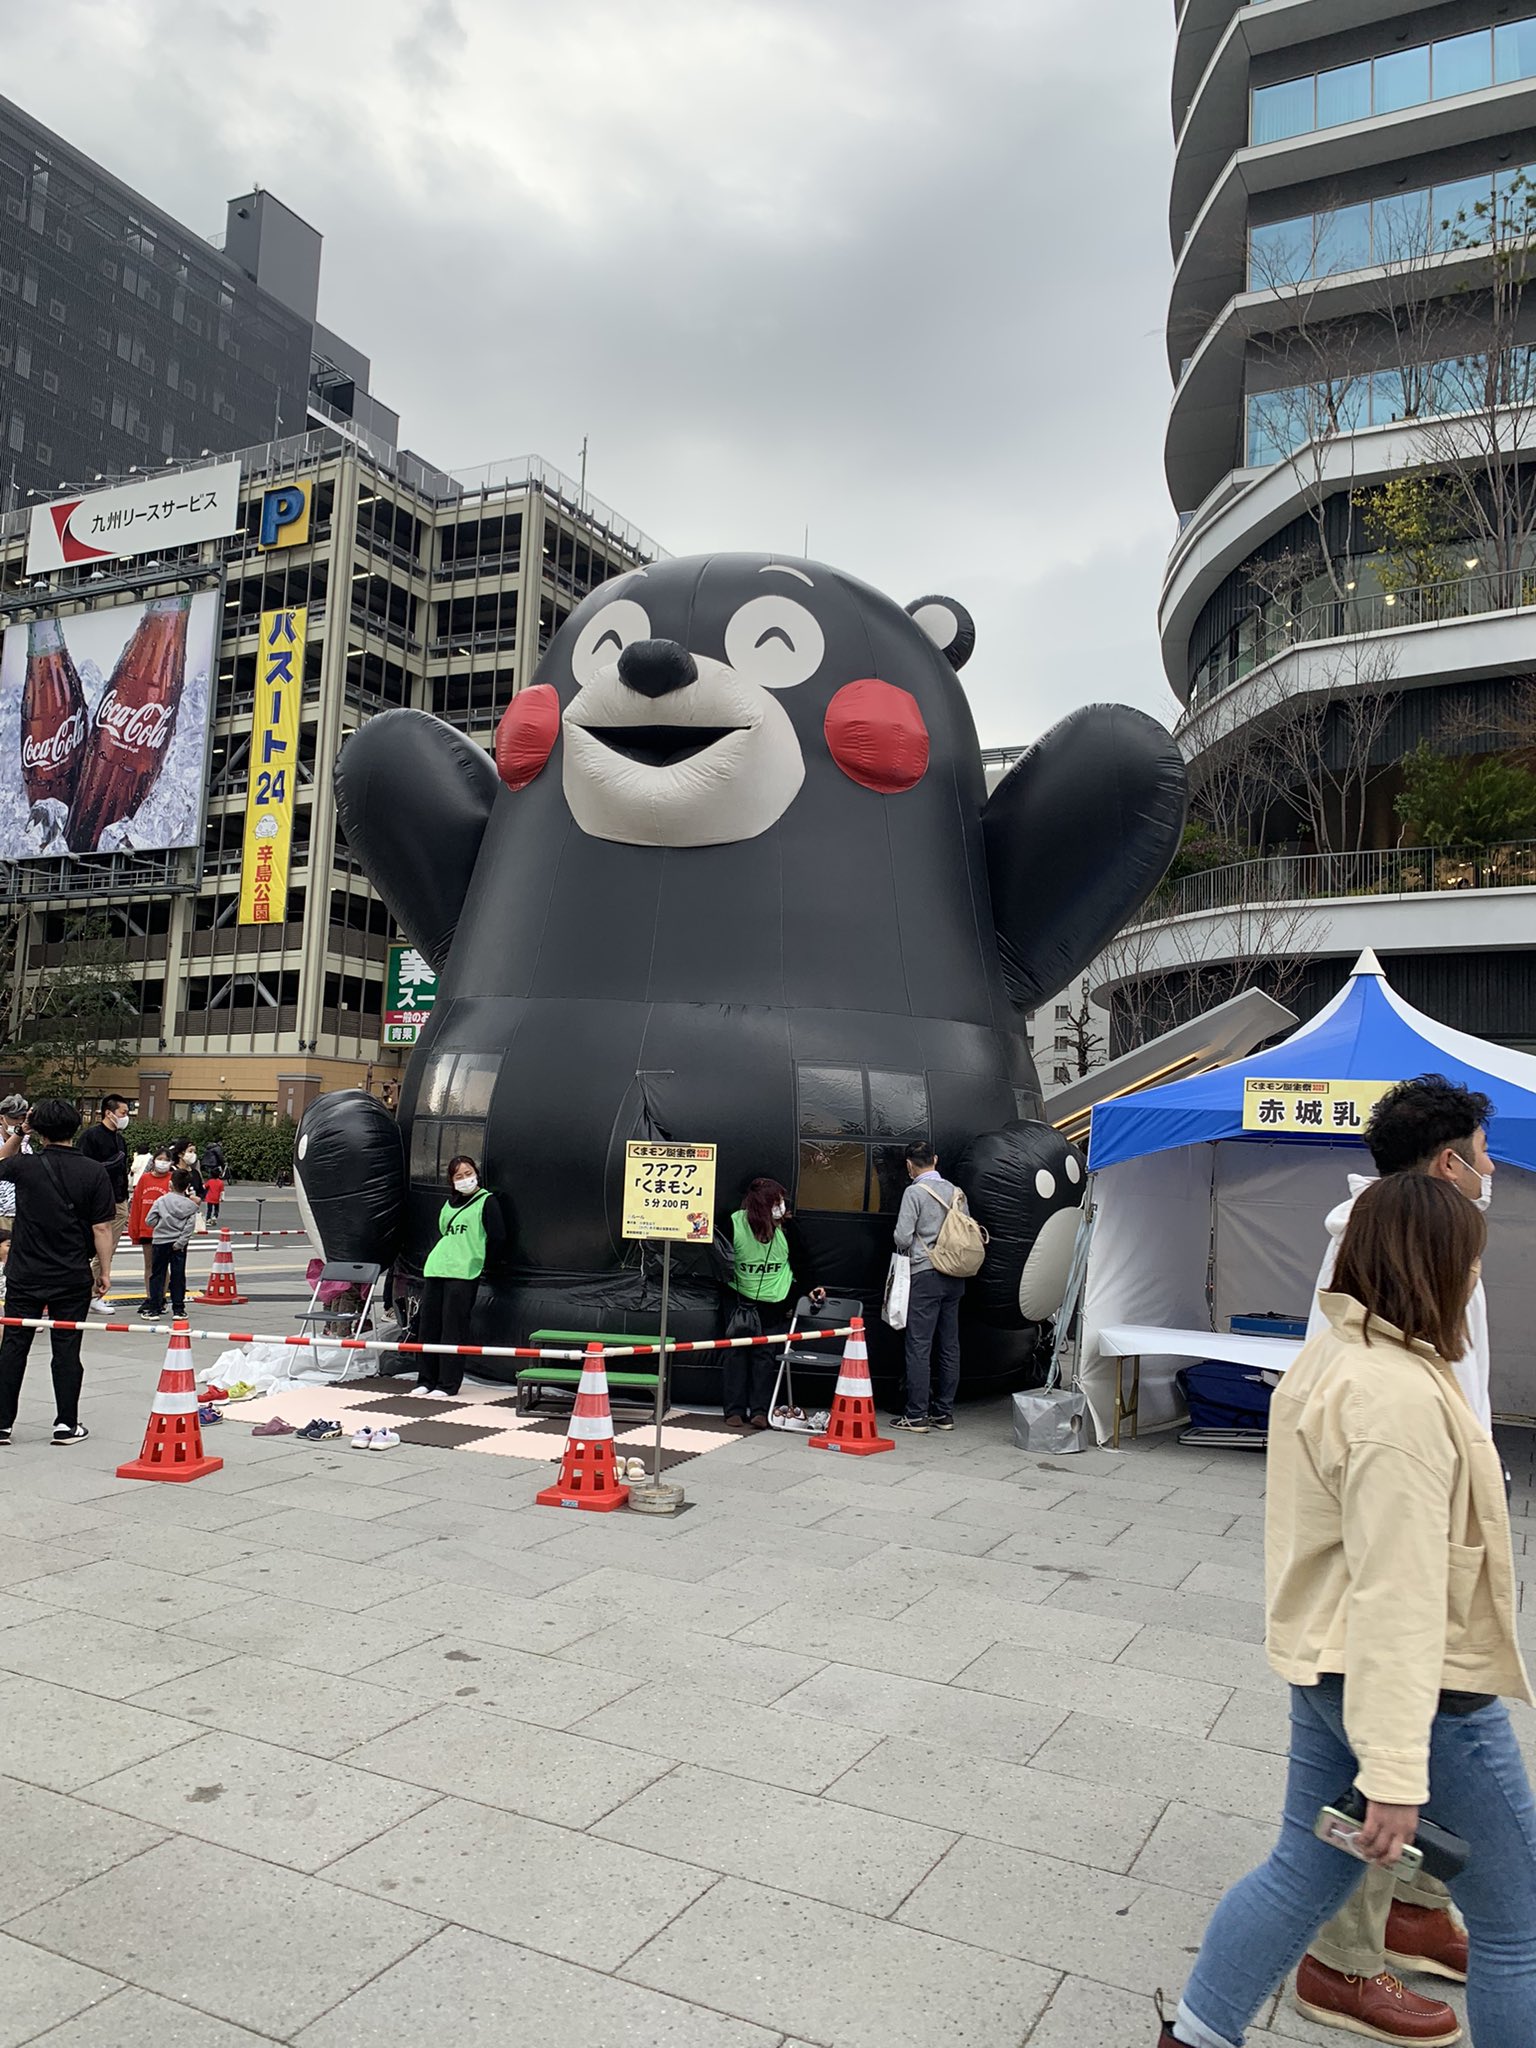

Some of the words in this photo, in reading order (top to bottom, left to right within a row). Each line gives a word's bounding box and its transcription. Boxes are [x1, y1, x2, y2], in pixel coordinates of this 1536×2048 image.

[91, 491, 218, 534] 九州リースサービス
[261, 486, 305, 545] P
[96, 689, 175, 749] Coca-Cola
[253, 845, 273, 922] 辛島公園
[392, 1027, 413, 1041] 青果
[1259, 1099, 1379, 1126] 赤城乳
[635, 1178, 702, 1196] 「くまモン」
[740, 1262, 782, 1274] STAFF
